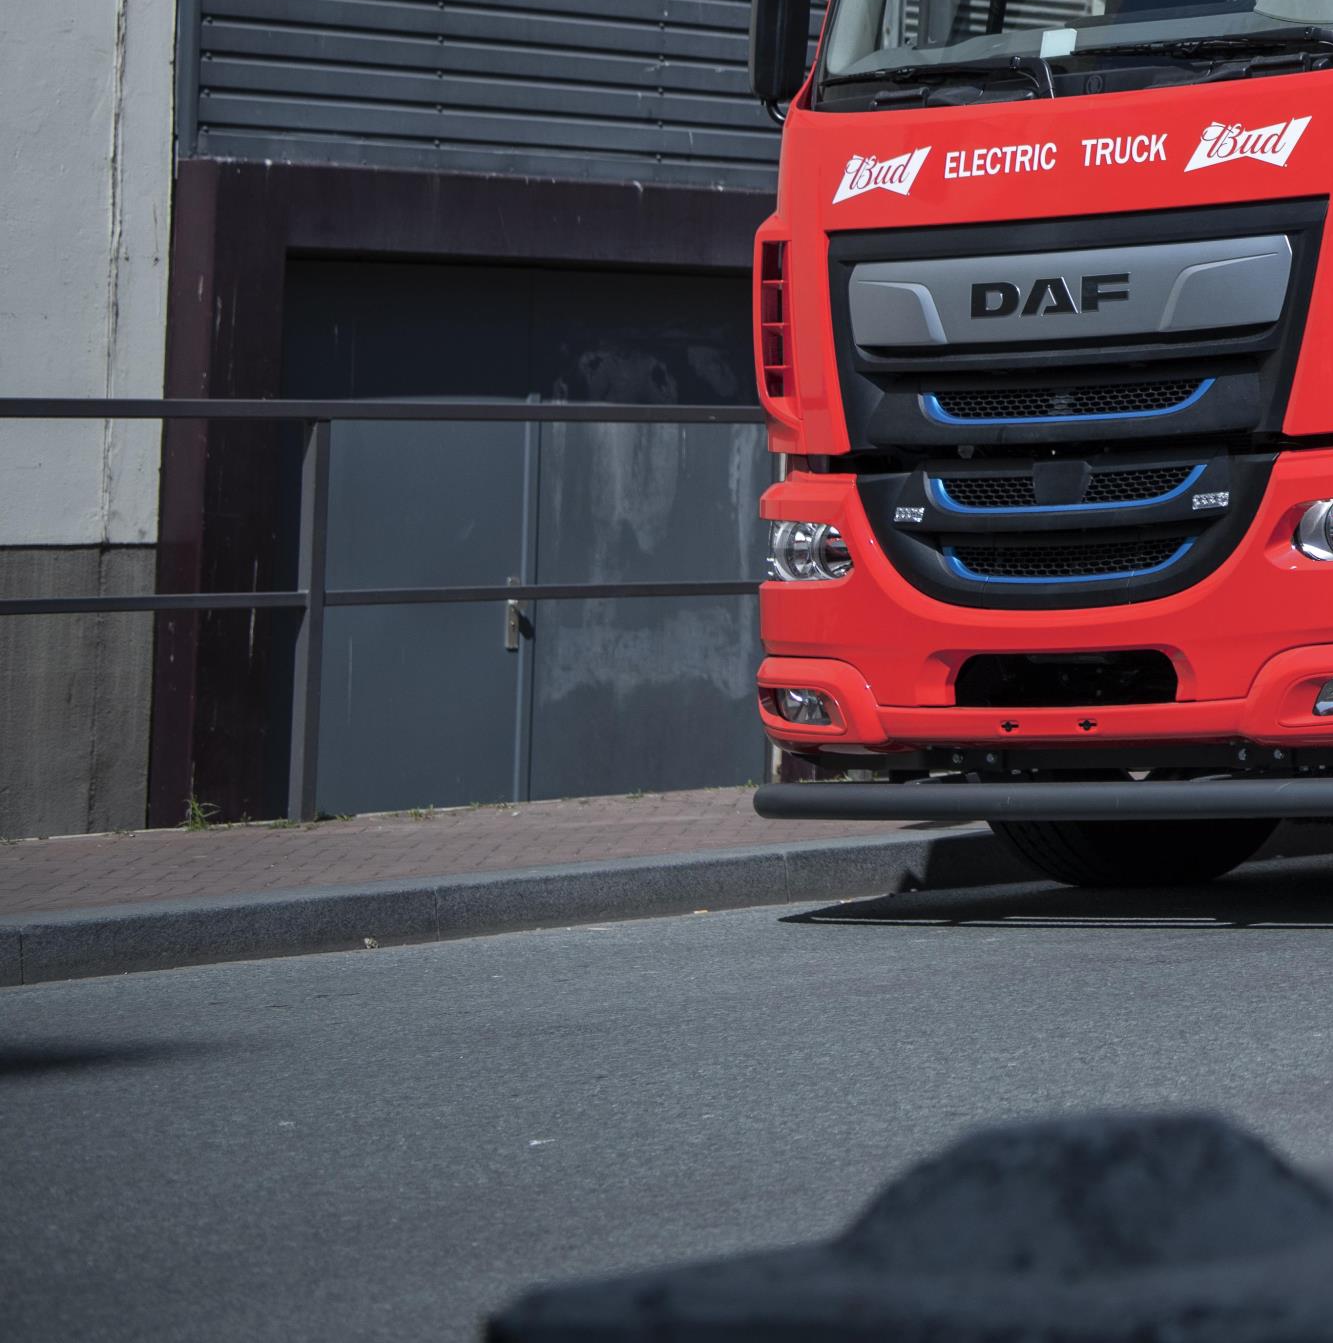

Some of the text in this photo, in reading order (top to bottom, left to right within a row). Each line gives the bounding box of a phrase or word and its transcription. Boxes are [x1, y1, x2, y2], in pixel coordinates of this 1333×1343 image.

[846, 121, 1289, 192] Bud ELECTRIC TRUCK Bud
[970, 271, 1131, 320] DAF
